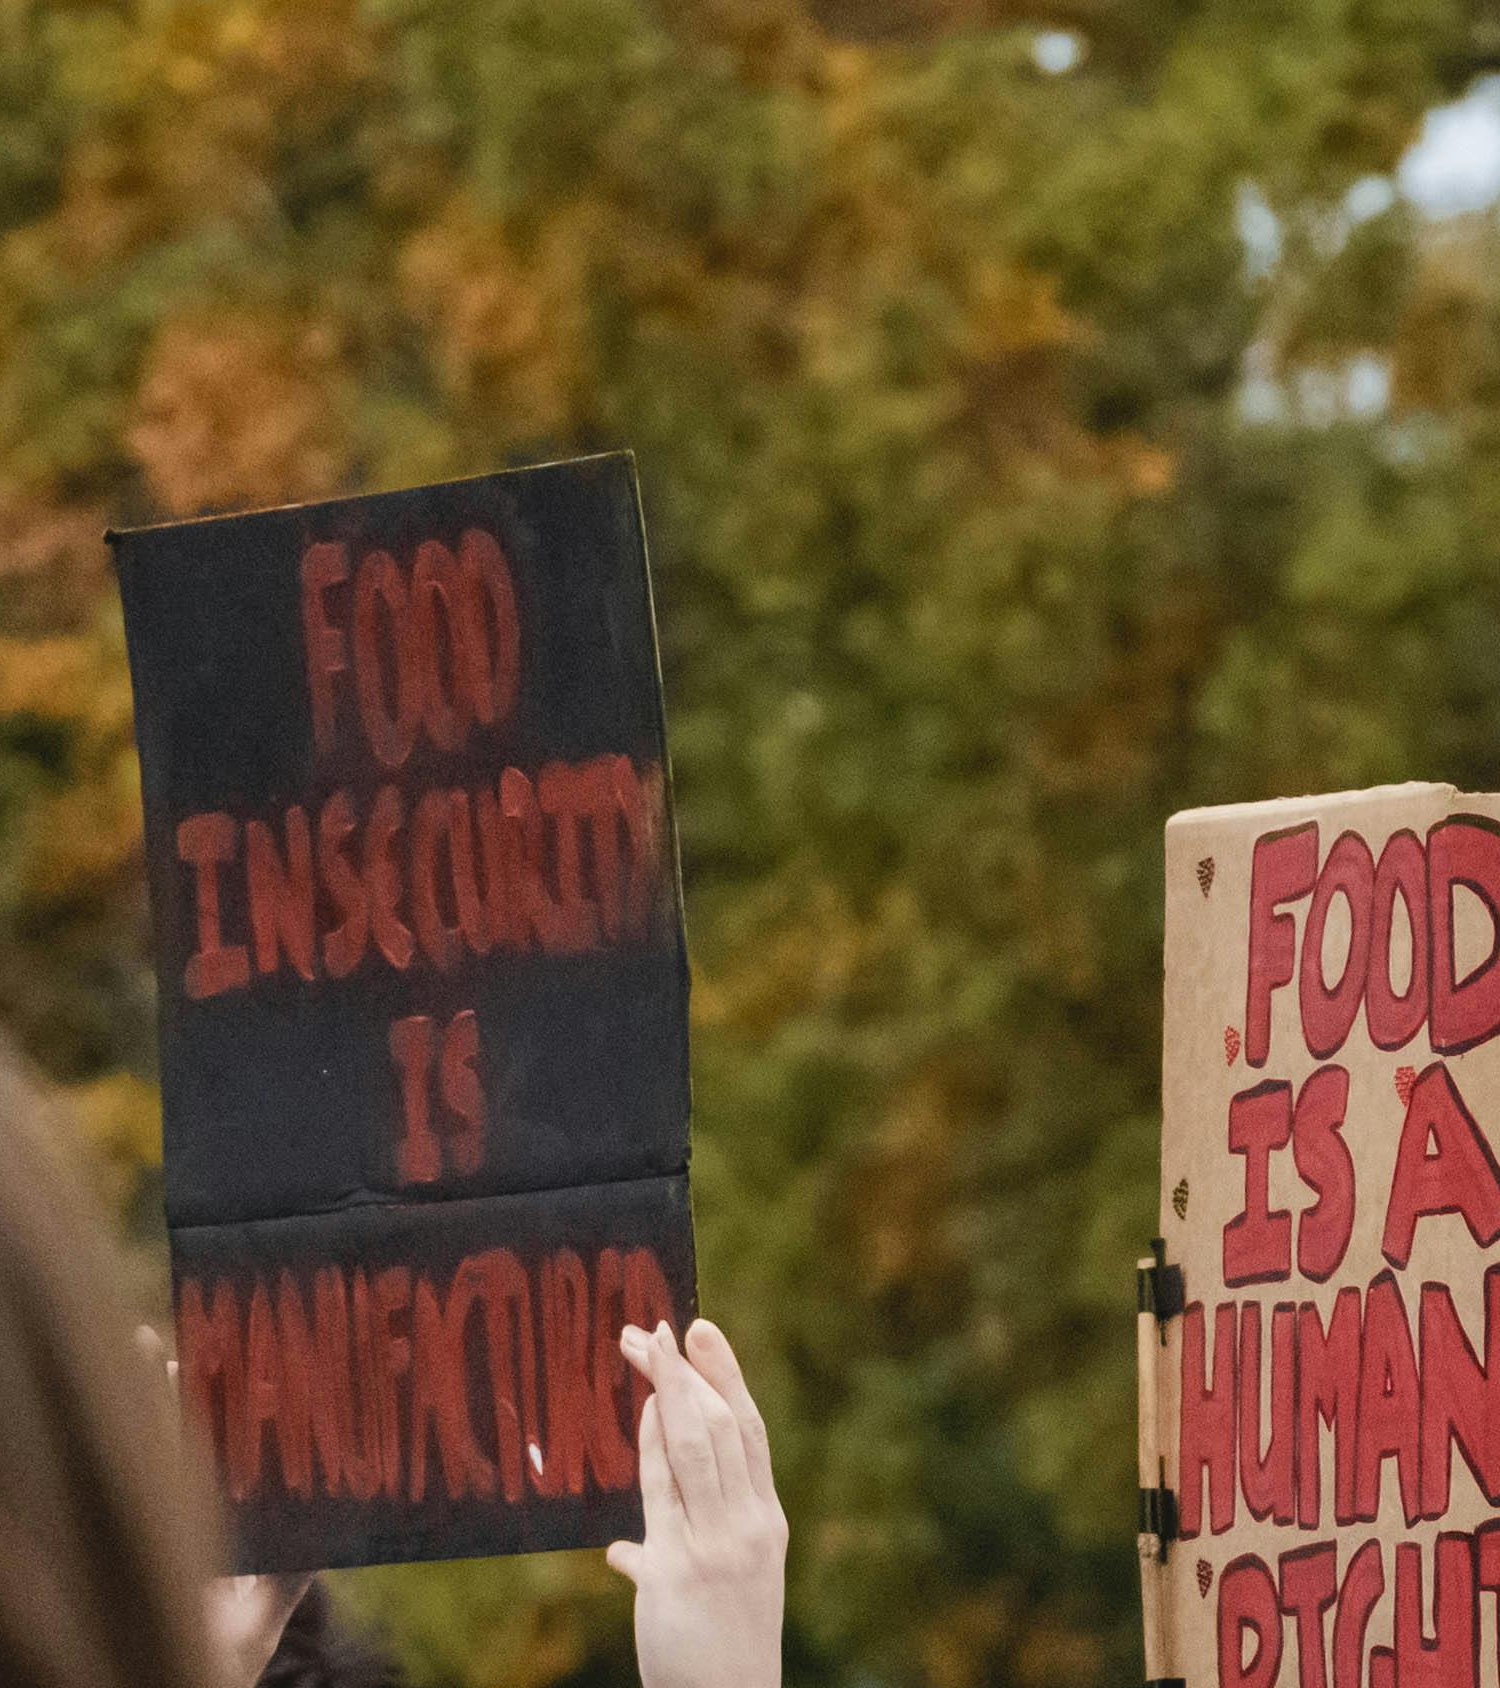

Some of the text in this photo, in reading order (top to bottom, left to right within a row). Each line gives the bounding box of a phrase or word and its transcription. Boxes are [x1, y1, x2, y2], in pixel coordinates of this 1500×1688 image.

[303, 525, 521, 770] FOOD
[389, 1008, 488, 1186] IS
[1222, 1064, 1350, 1289] IS
